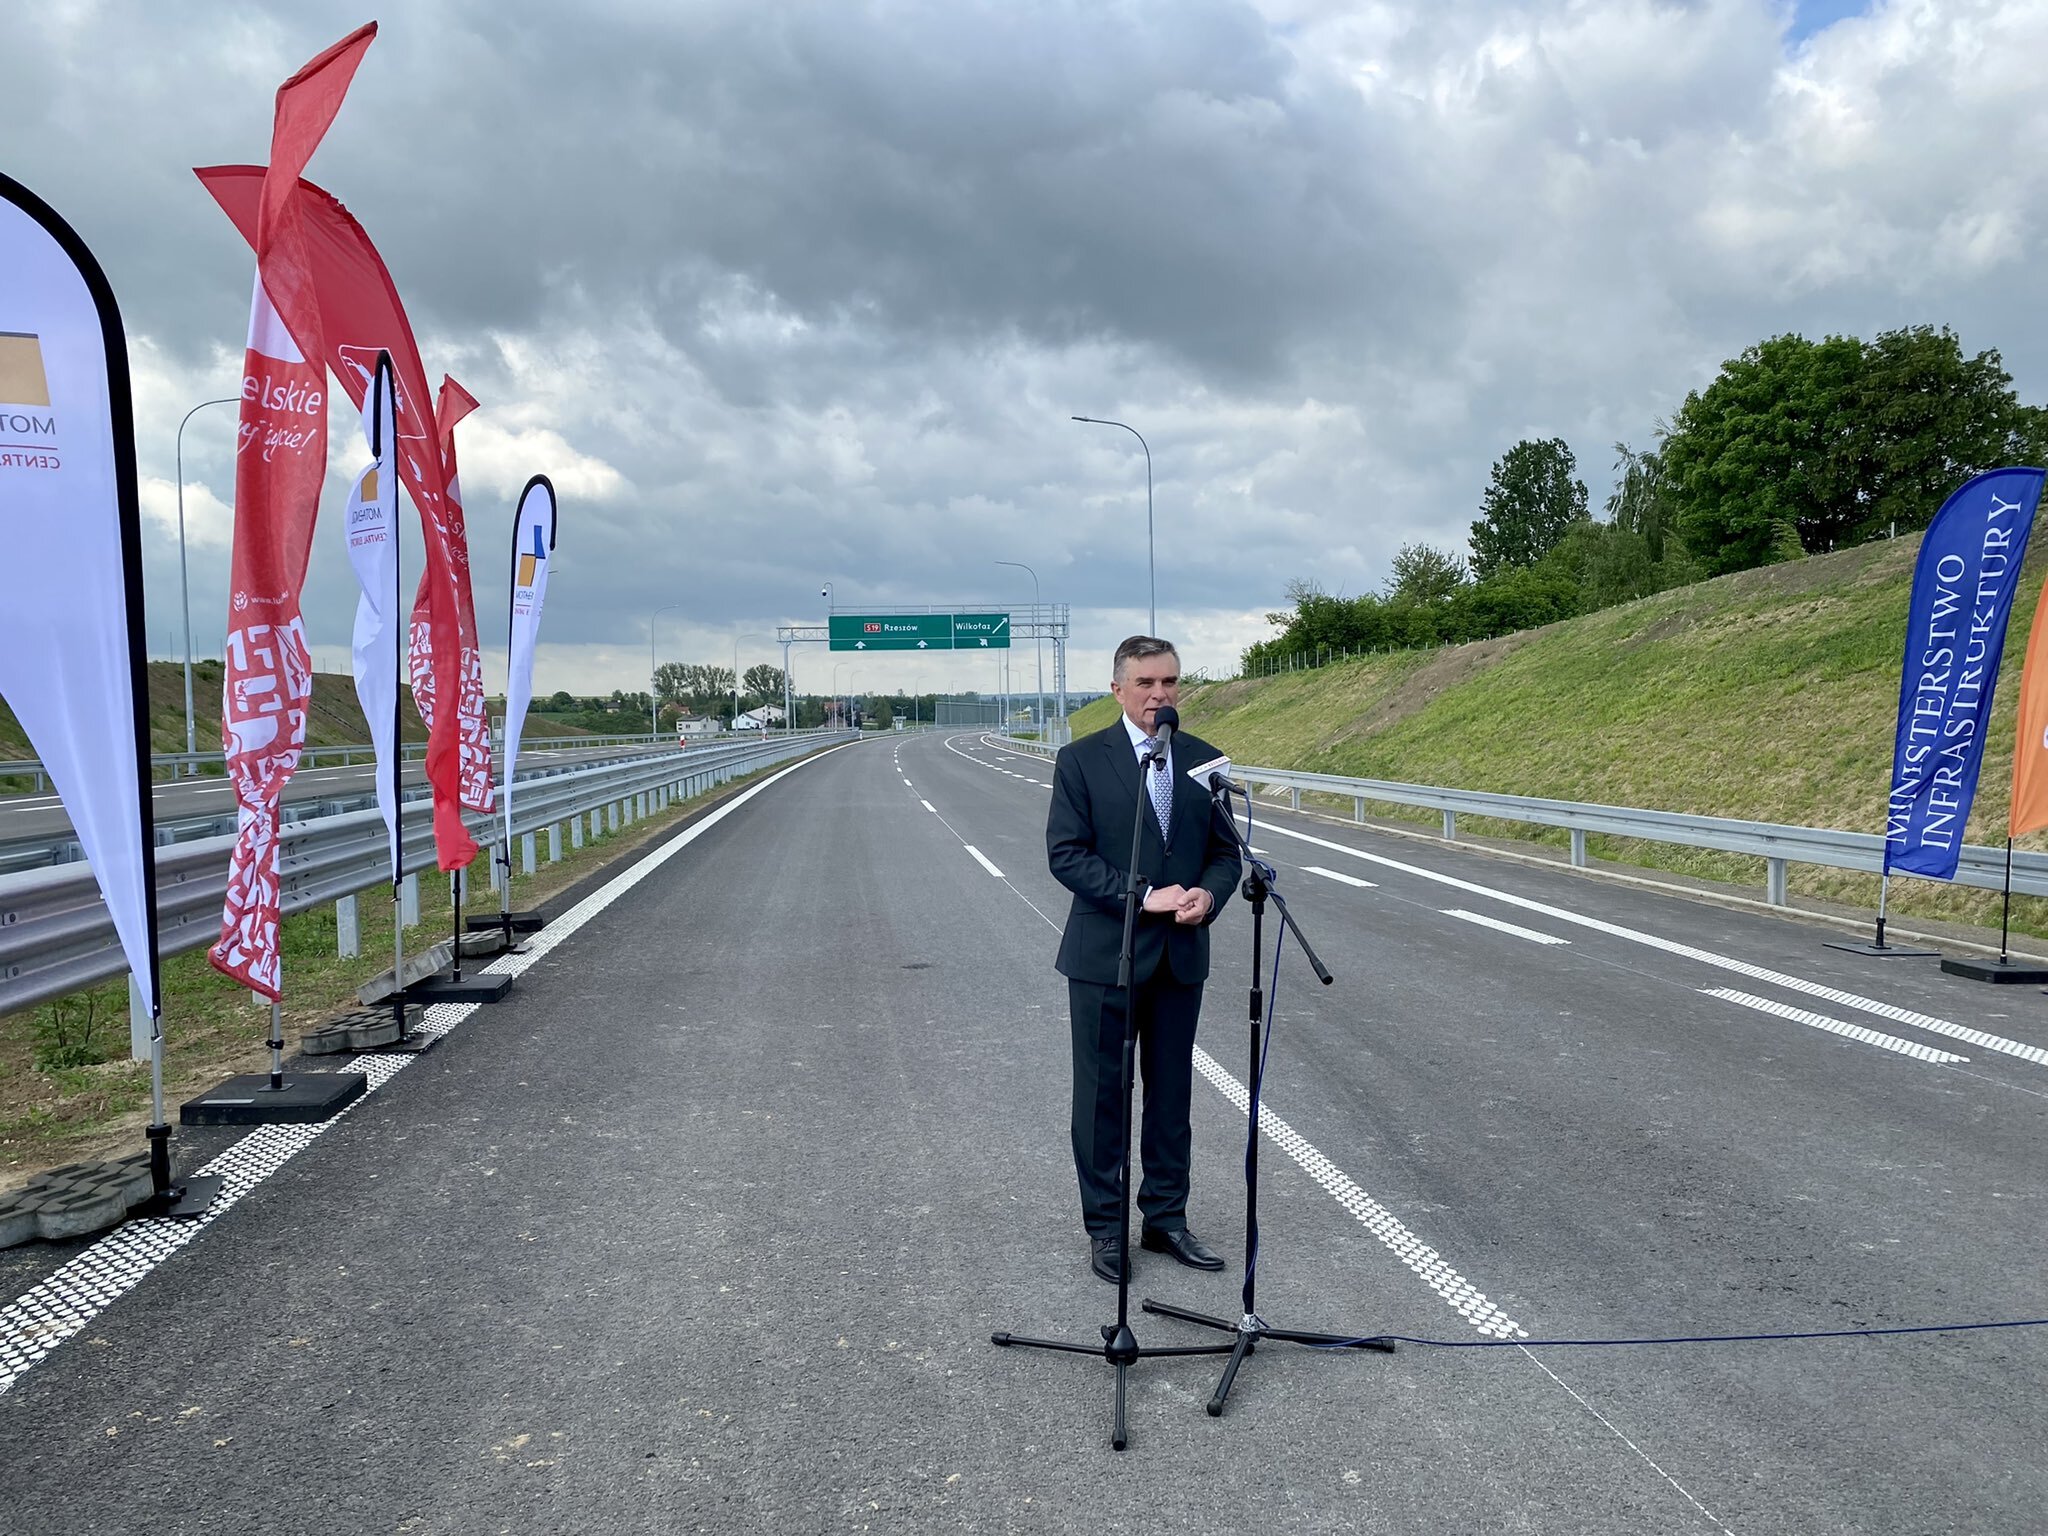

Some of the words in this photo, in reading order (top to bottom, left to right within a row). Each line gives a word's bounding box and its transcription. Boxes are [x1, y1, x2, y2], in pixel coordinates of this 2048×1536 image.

[884, 623, 918, 632] Rzeszów
[955, 622, 992, 631] Wilkołaz
[1885, 554, 1965, 846] MINISTERSTWO
[1920, 492, 2022, 852] INFRASTRUKTURY
